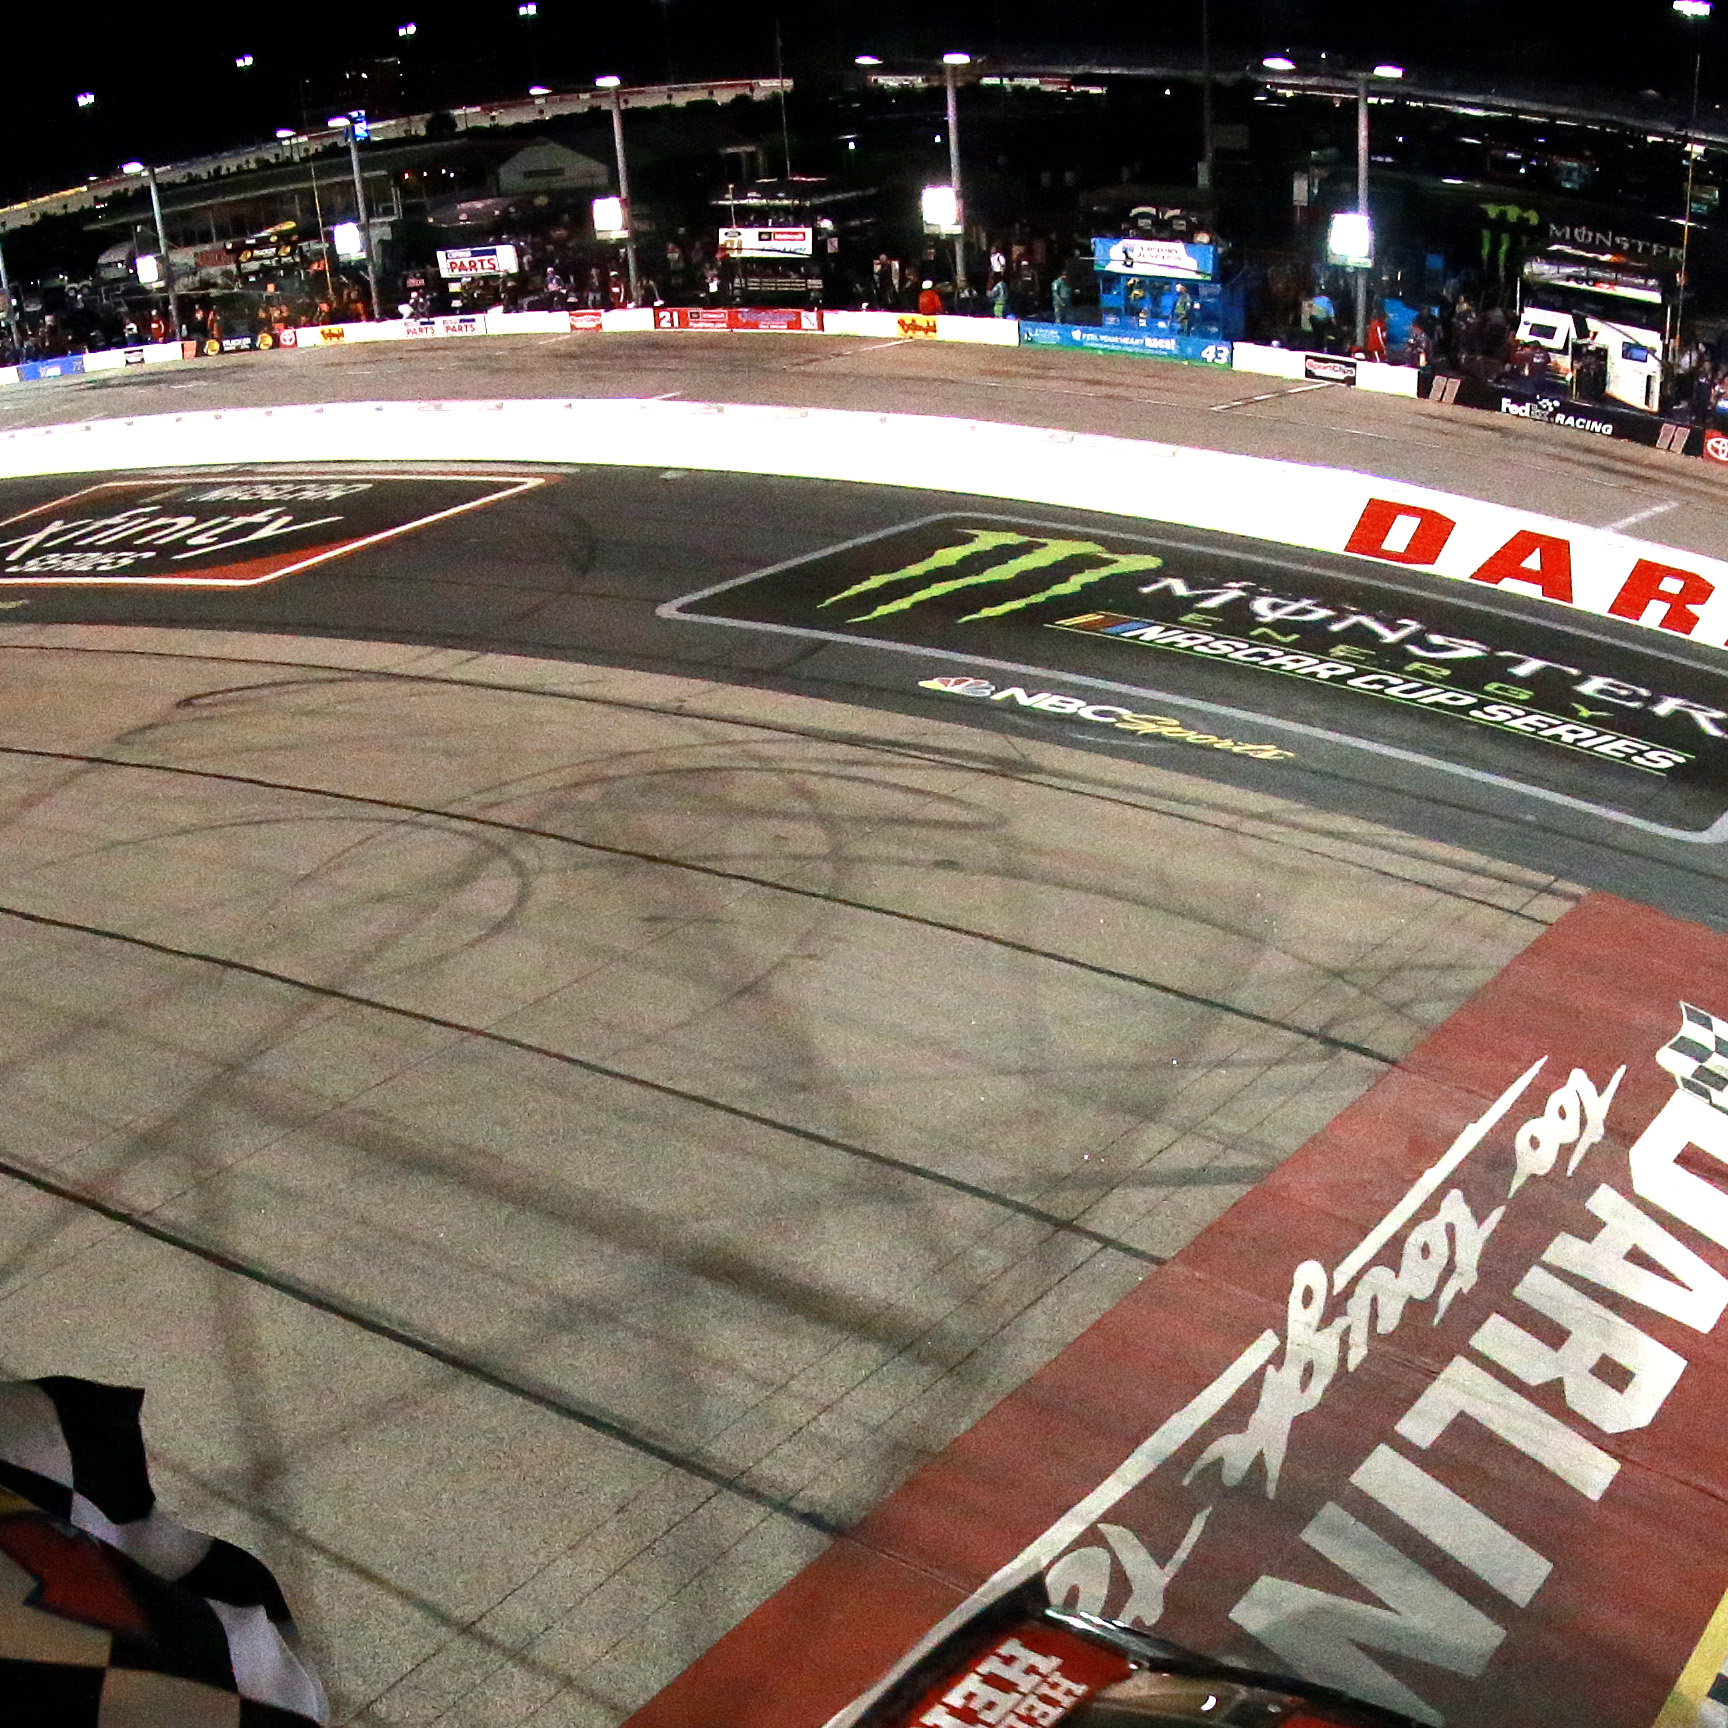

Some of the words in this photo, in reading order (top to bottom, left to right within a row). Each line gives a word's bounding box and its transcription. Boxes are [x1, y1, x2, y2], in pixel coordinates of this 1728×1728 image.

[448, 257, 498, 274] PARTS
[658, 311, 679, 328] 21
[1201, 345, 1230, 364] 43
[1555, 413, 1614, 436] RACING
[1176, 613, 1614, 718] ENERGY
[1121, 622, 1359, 680] NASCAR
[1347, 670, 1478, 709] CUP
[1468, 702, 1690, 773] SERIES
